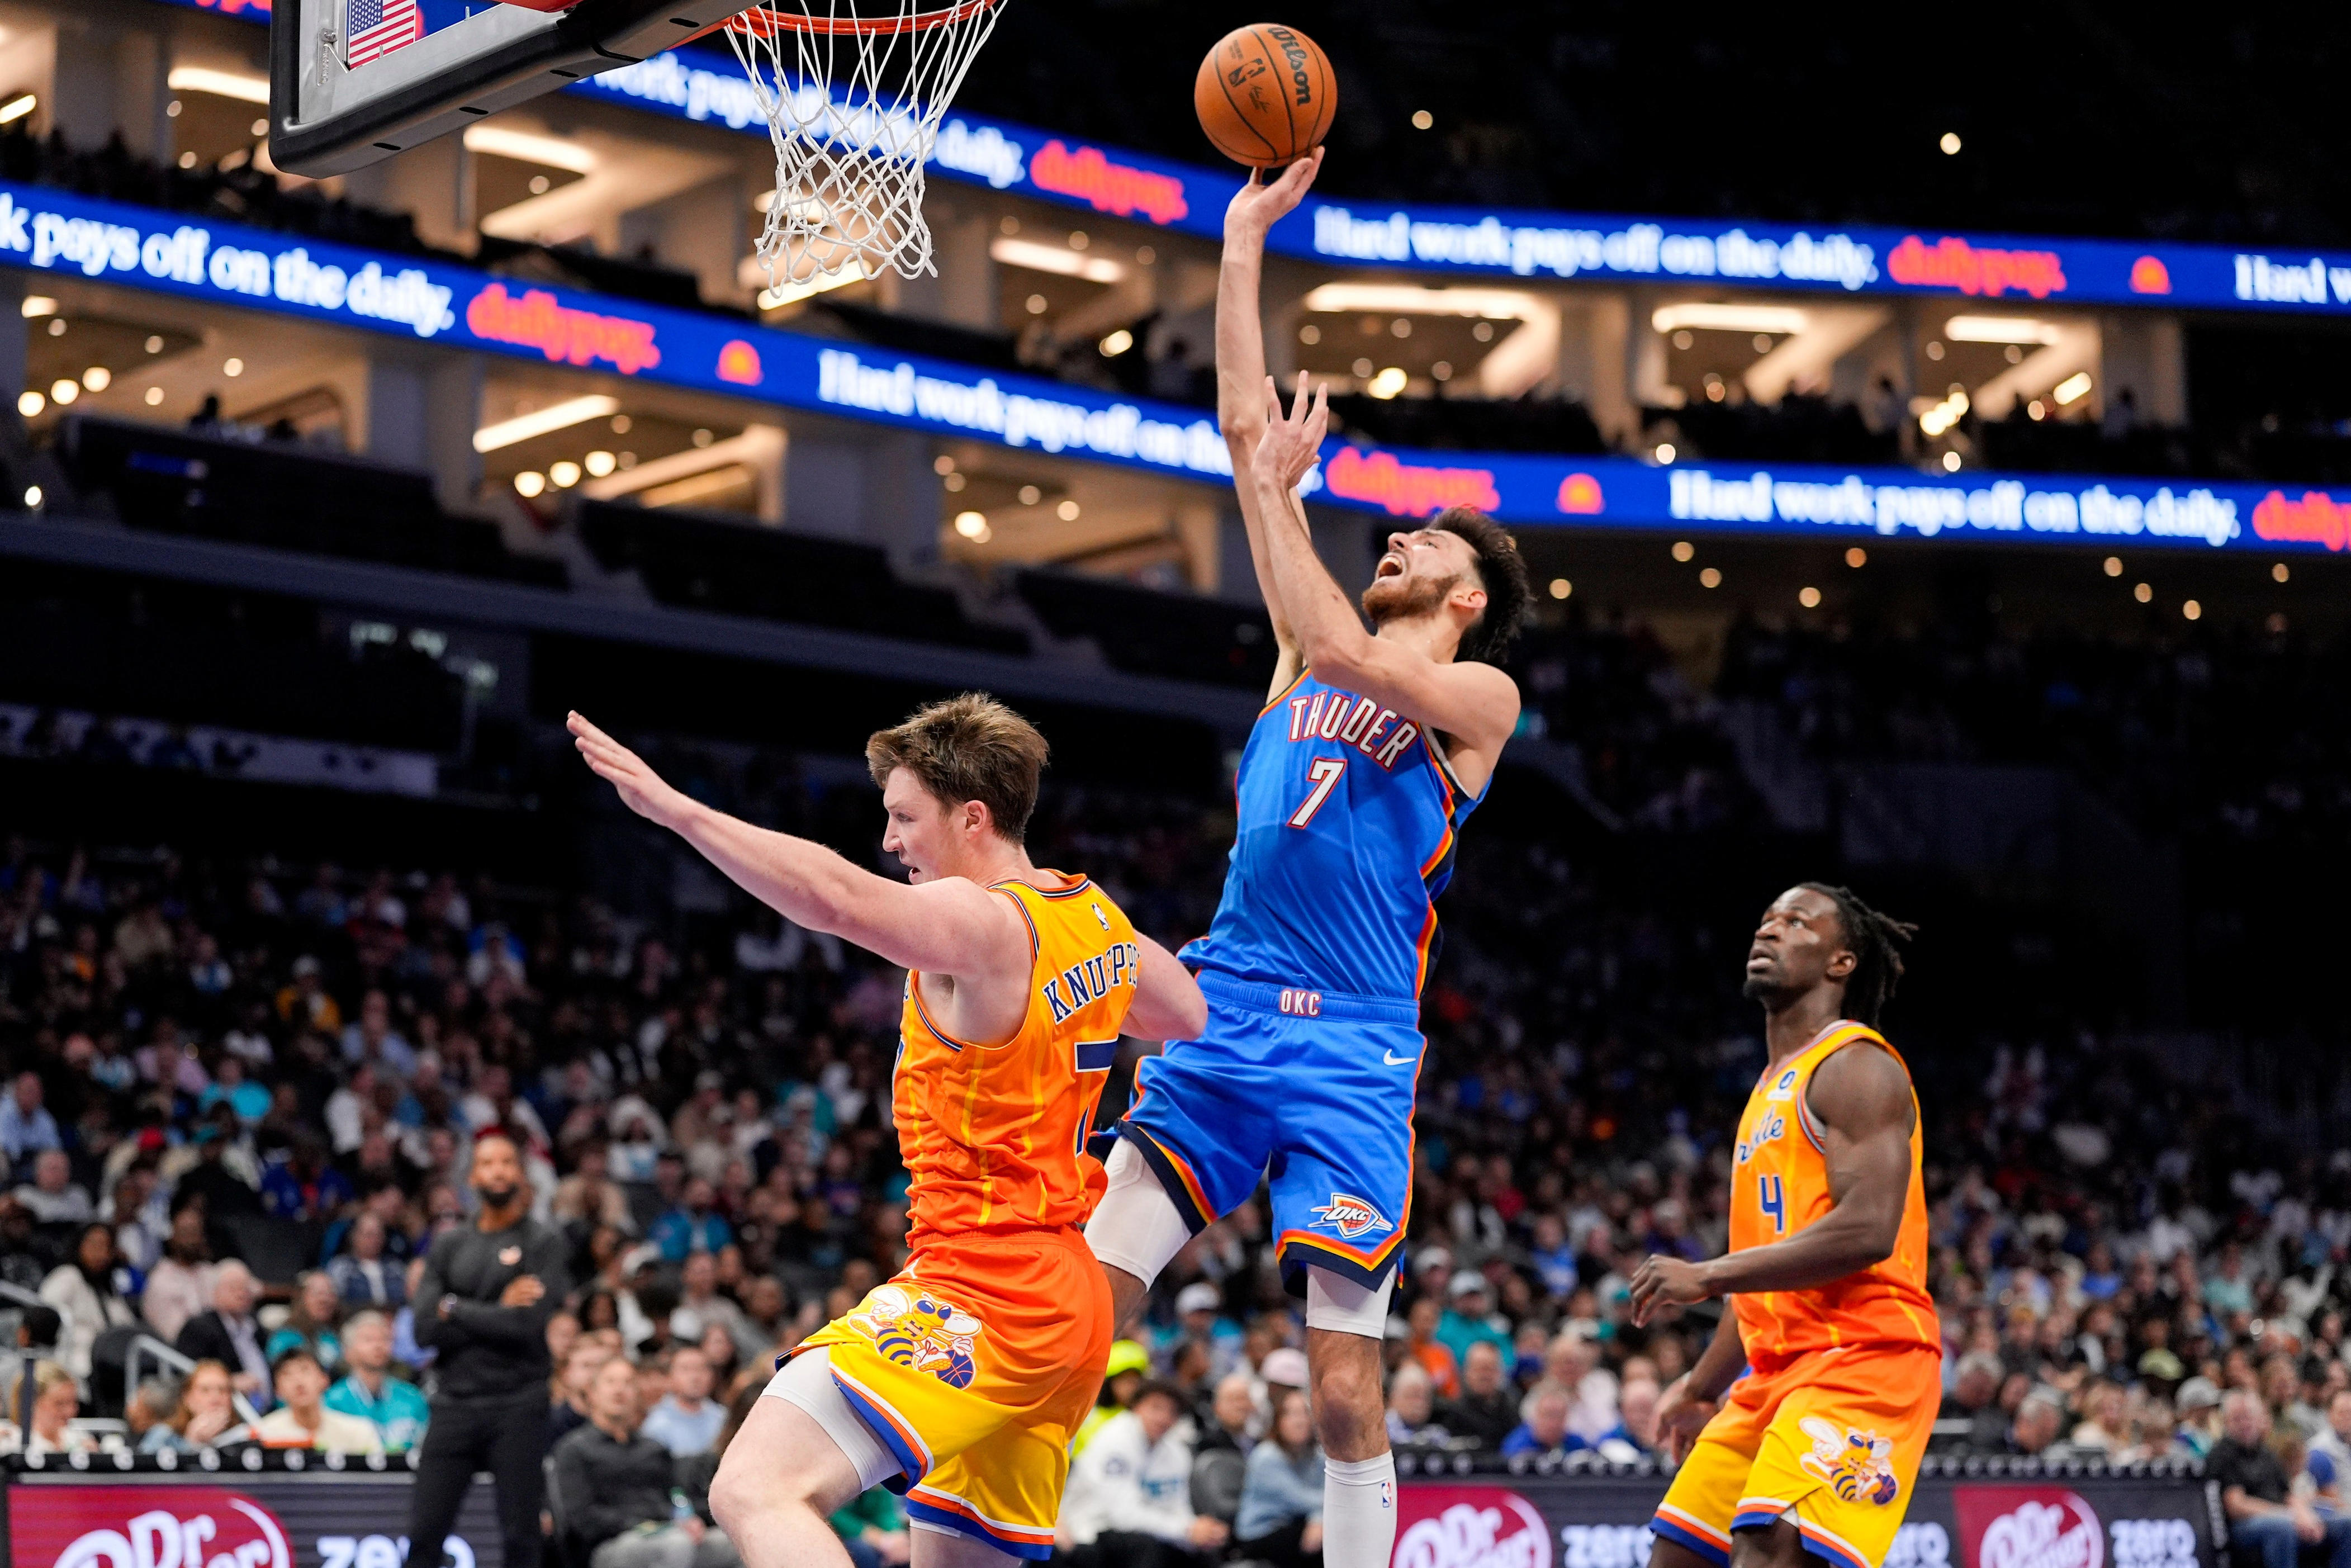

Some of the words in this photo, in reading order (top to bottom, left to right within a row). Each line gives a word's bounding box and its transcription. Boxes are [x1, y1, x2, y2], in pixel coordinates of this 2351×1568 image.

[1267, 27, 1311, 106] Wilson
[30, 211, 140, 276] pays
[141, 226, 210, 285] off
[208, 245, 272, 297] on
[272, 247, 348, 309] the
[347, 261, 456, 337] daily.
[1314, 205, 1411, 261] Hard
[1410, 216, 1511, 266] work
[1510, 228, 1604, 277] pays
[1603, 223, 1663, 273] off
[1660, 235, 1715, 276] on
[1715, 228, 1781, 278] the
[2233, 254, 2329, 304] Hard
[818, 349, 915, 416] Hard
[914, 376, 1006, 434] work
[1004, 395, 1088, 453] pays
[1084, 403, 1141, 458] off
[1135, 420, 1184, 467] on
[1668, 470, 1773, 522] Hard
[1772, 475, 1876, 526] work
[1875, 485, 1968, 537] pays
[1966, 480, 2026, 530] off
[2023, 491, 2080, 533] on
[2080, 484, 2145, 535] the
[1286, 756, 1348, 830] 7
[1280, 989, 1320, 1017] OKC
[1323, 1206, 1370, 1221] OKC
[1758, 1173, 1784, 1234] 4
